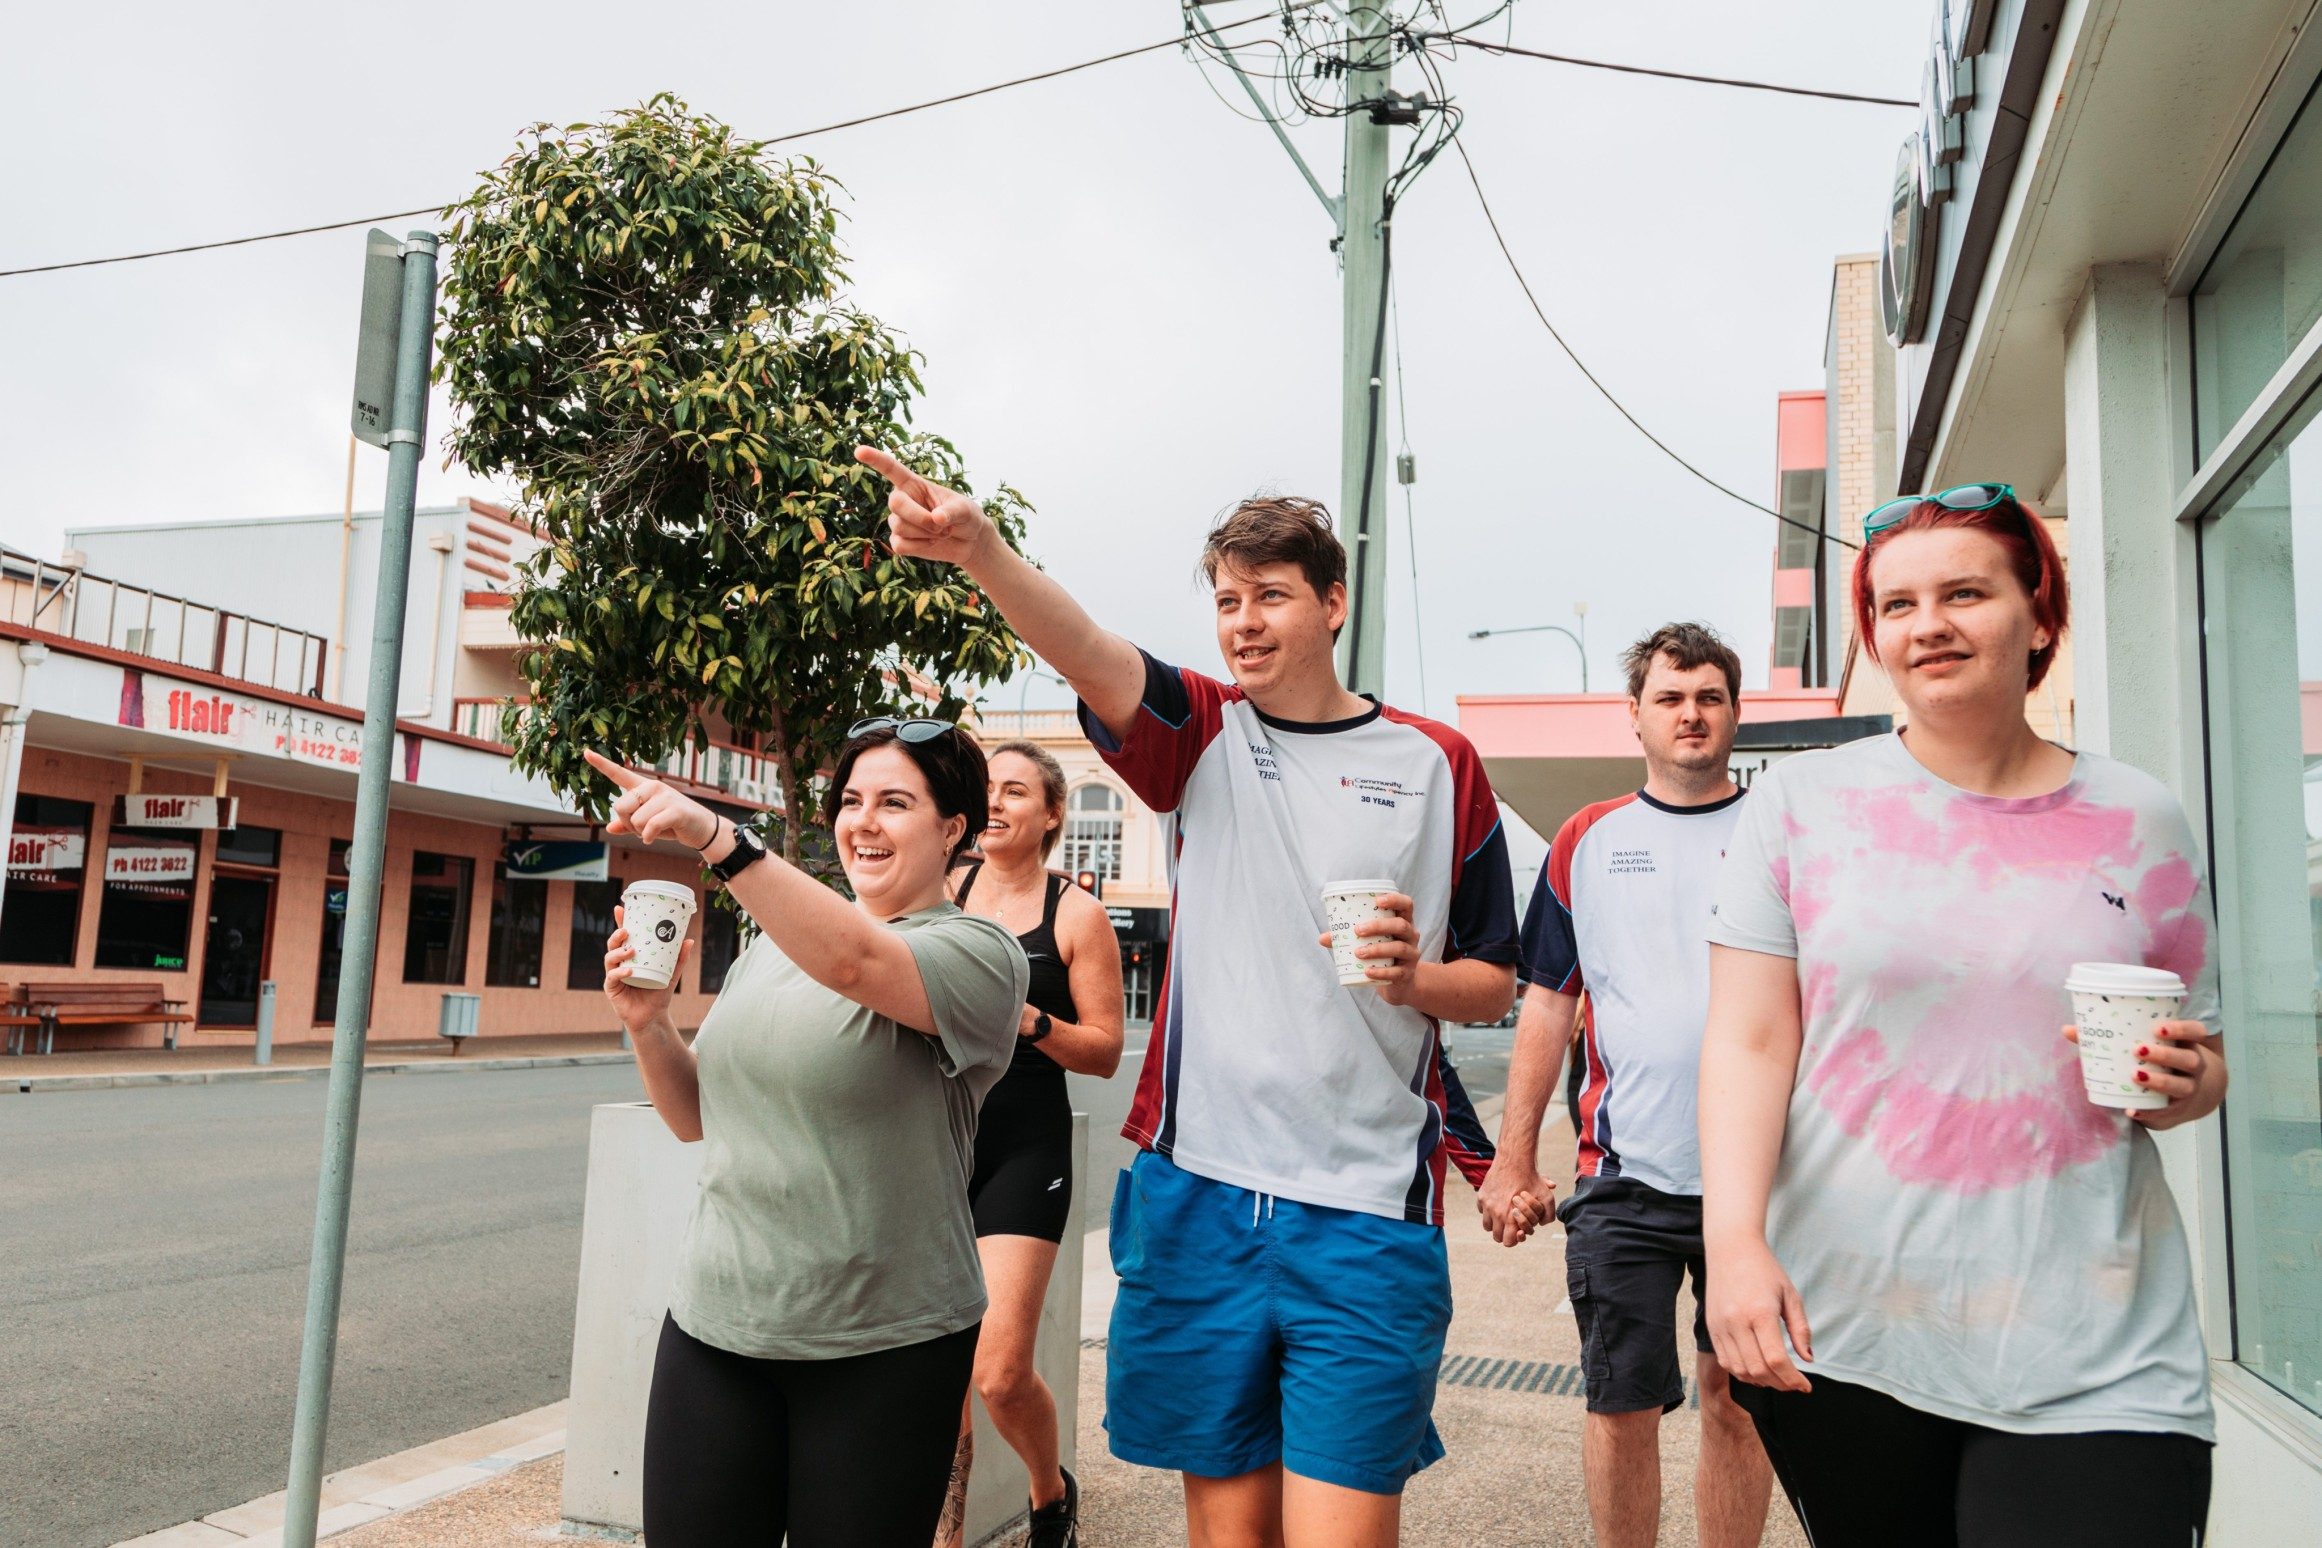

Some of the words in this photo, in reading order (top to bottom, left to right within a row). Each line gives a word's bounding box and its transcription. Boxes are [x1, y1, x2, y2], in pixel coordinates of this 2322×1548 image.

[168, 690, 233, 735] flair
[266, 710, 324, 737] HAIR
[335, 726, 360, 745] CA
[145, 798, 185, 819] flair
[1361, 795, 1371, 803] 30
[1372, 797, 1395, 808] YEARS
[8, 837, 46, 865] lair
[131, 857, 158, 872] 4122
[1610, 858, 1653, 866] AMAZING
[6, 871, 26, 880] AIR
[29, 872, 58, 883] CARE
[1608, 866, 1656, 874] TOGETHER
